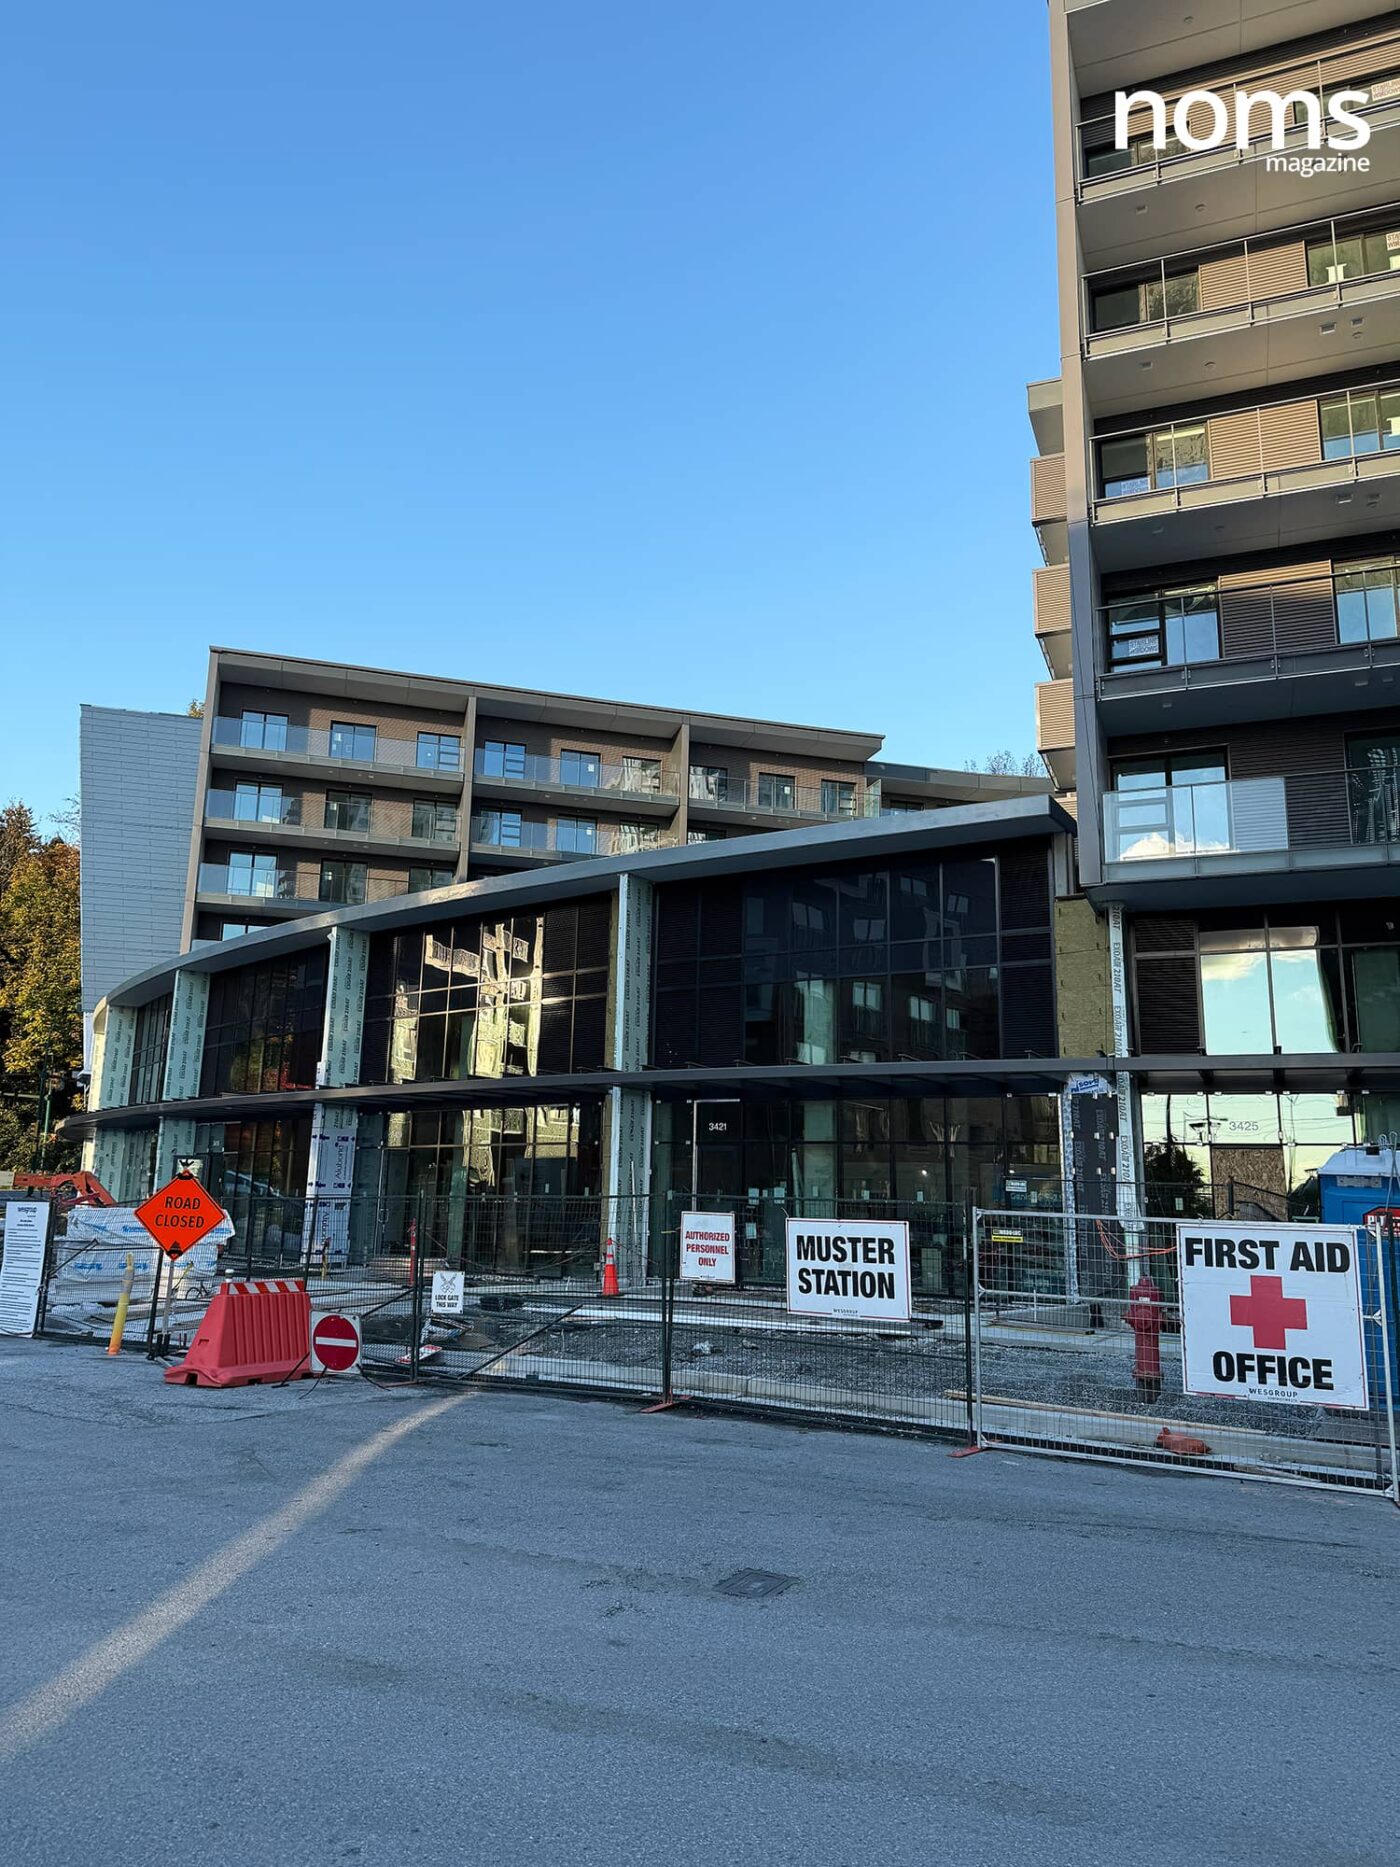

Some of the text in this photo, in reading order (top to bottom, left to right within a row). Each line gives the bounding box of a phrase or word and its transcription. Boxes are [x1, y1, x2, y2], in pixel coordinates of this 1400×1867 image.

[708, 1122, 727, 1132] 3421
[1228, 1120, 1259, 1132] 3425
[165, 1196, 201, 1210] ROAD
[155, 1214, 205, 1228] CLOSED
[685, 1230, 730, 1241] AUTHORIZED
[686, 1243, 729, 1255] PERSONNEL
[796, 1235, 896, 1265] MUSTER
[1185, 1237, 1350, 1273] FIRST AID
[698, 1256, 717, 1267] ONLY
[798, 1268, 895, 1299] STATION
[1212, 1350, 1335, 1391] OFFICE
[1248, 1387, 1298, 1398] WESGROUP
